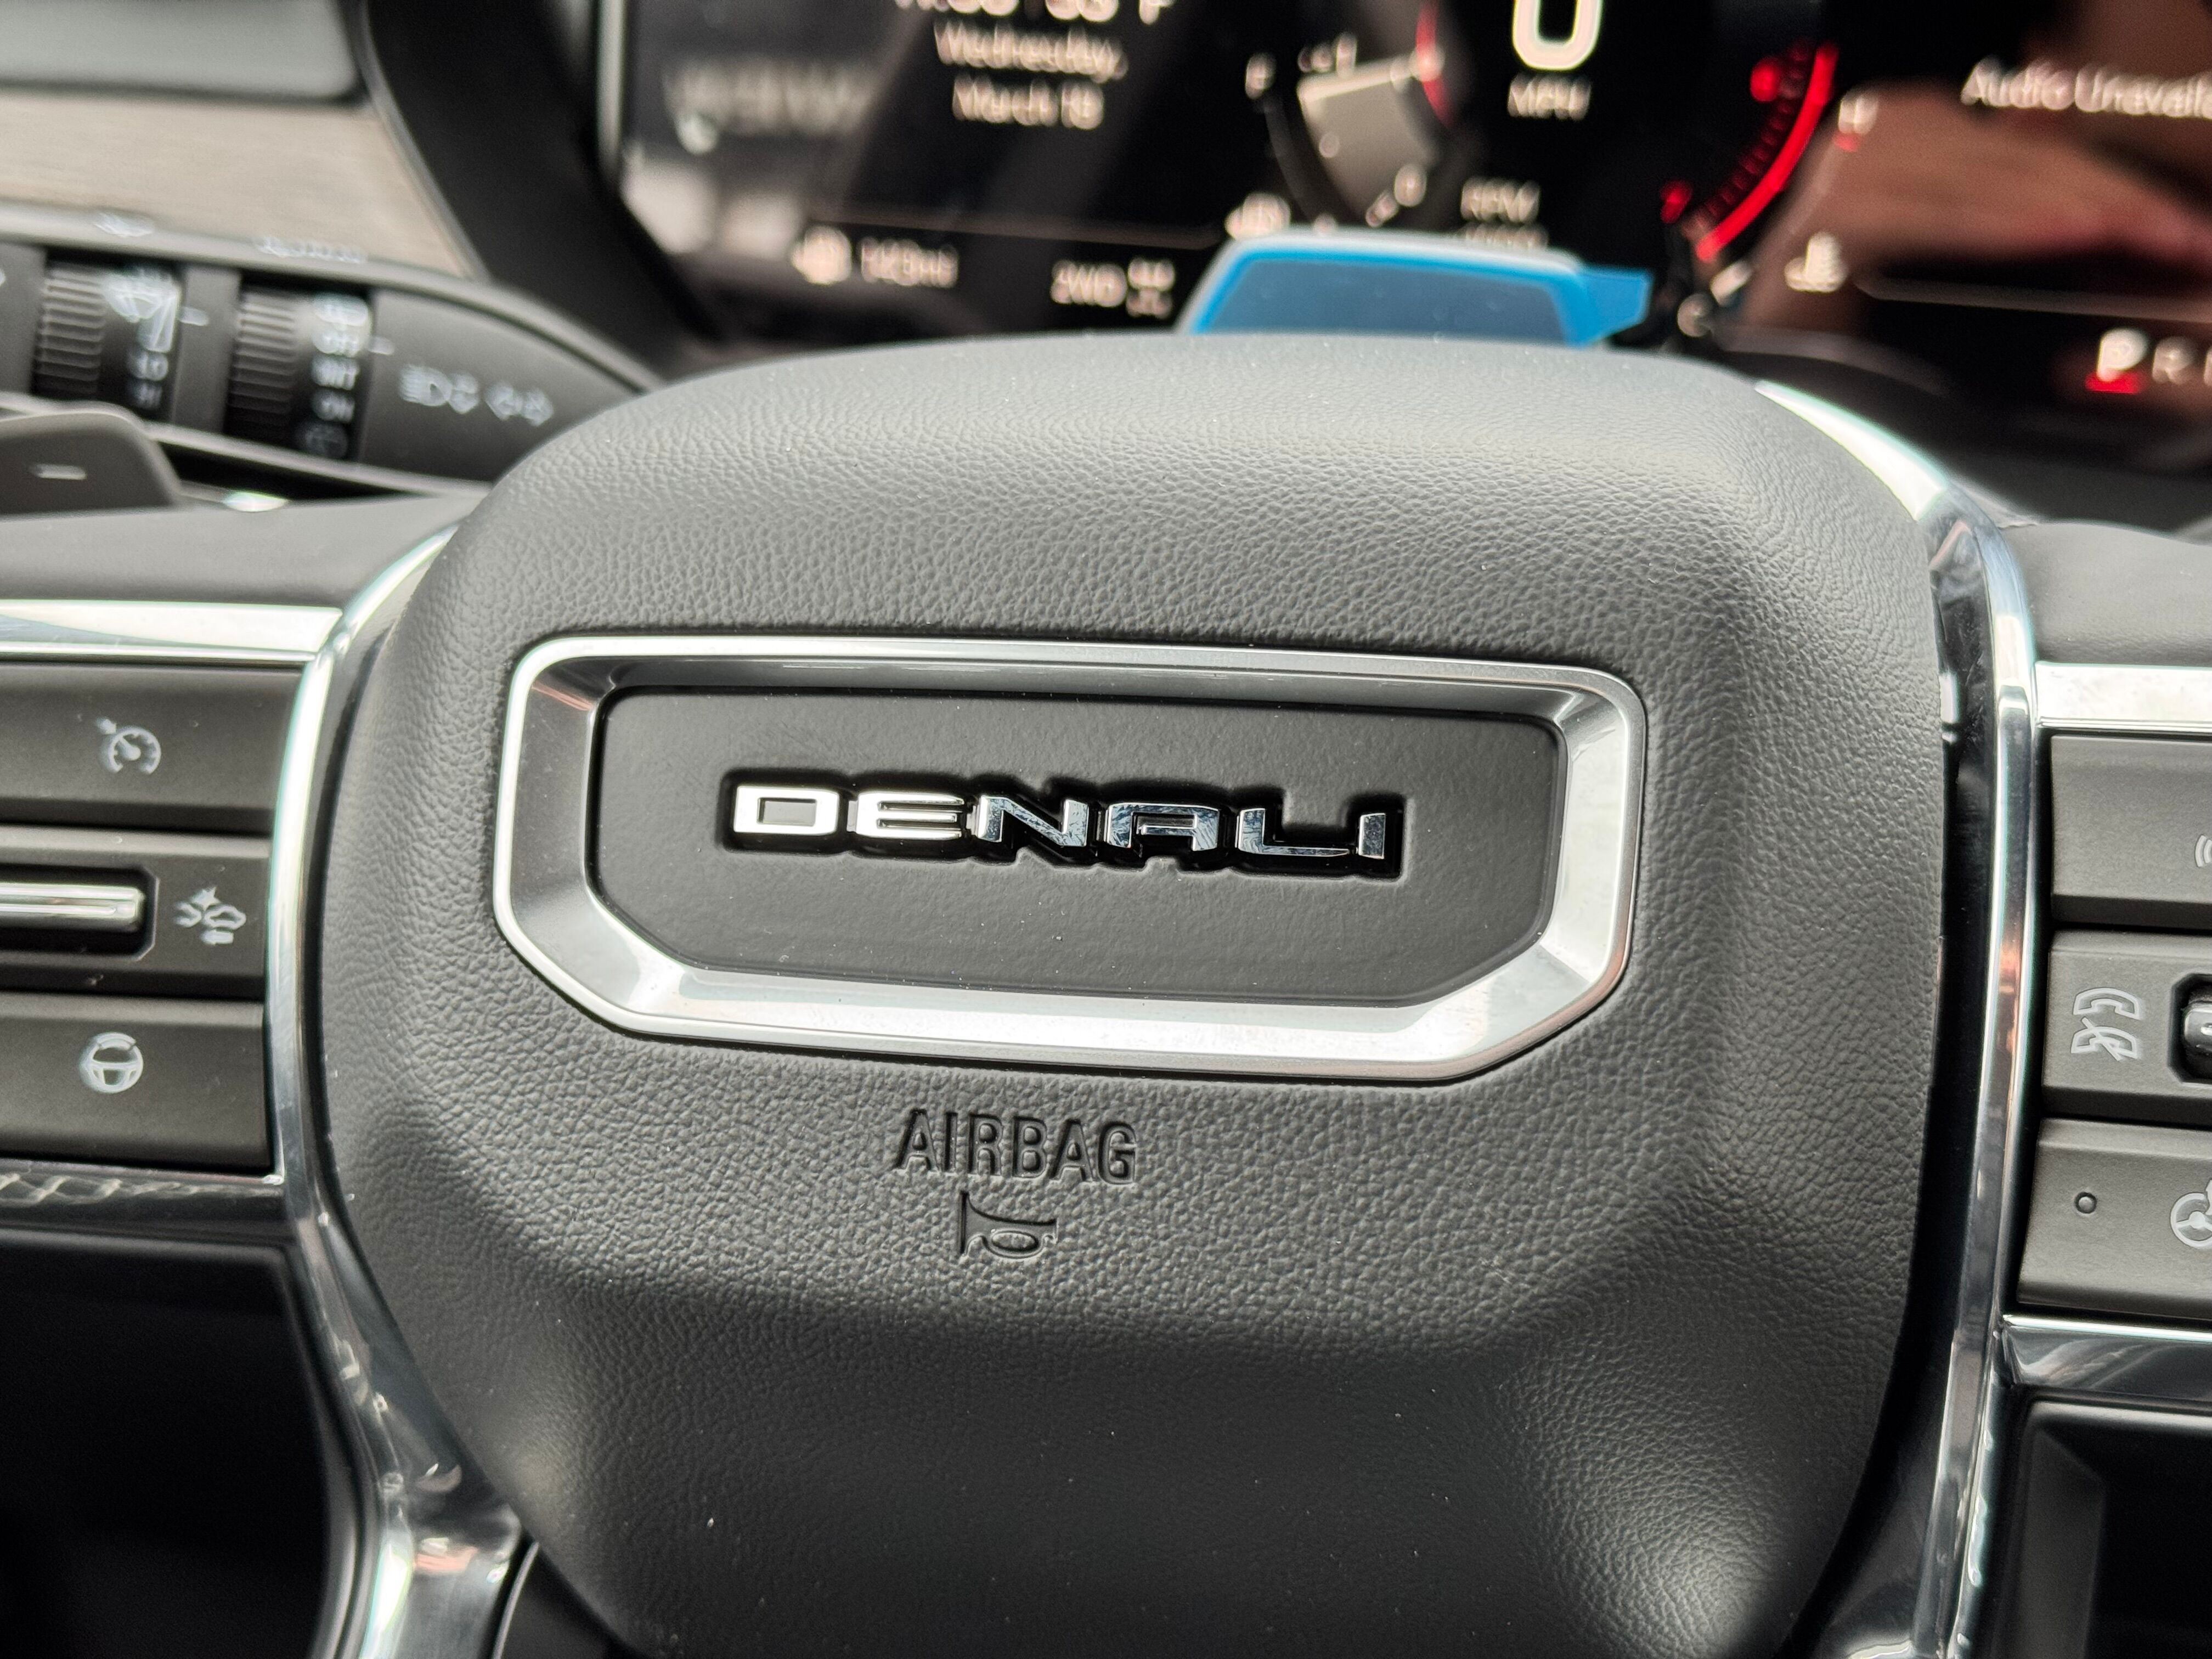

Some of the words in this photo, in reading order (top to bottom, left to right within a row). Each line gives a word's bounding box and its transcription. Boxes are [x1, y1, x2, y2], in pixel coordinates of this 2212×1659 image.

[952, 74, 1059, 126] March
[1508, 74, 1590, 120] MPH
[1960, 57, 2075, 110] Audio
[1460, 177, 1540, 222] RPM
[2096, 328, 2149, 382] P
[2152, 336, 2194, 384] R
[732, 783, 1387, 860] DENALI
[891, 1108, 1138, 1185] AIRBAG
